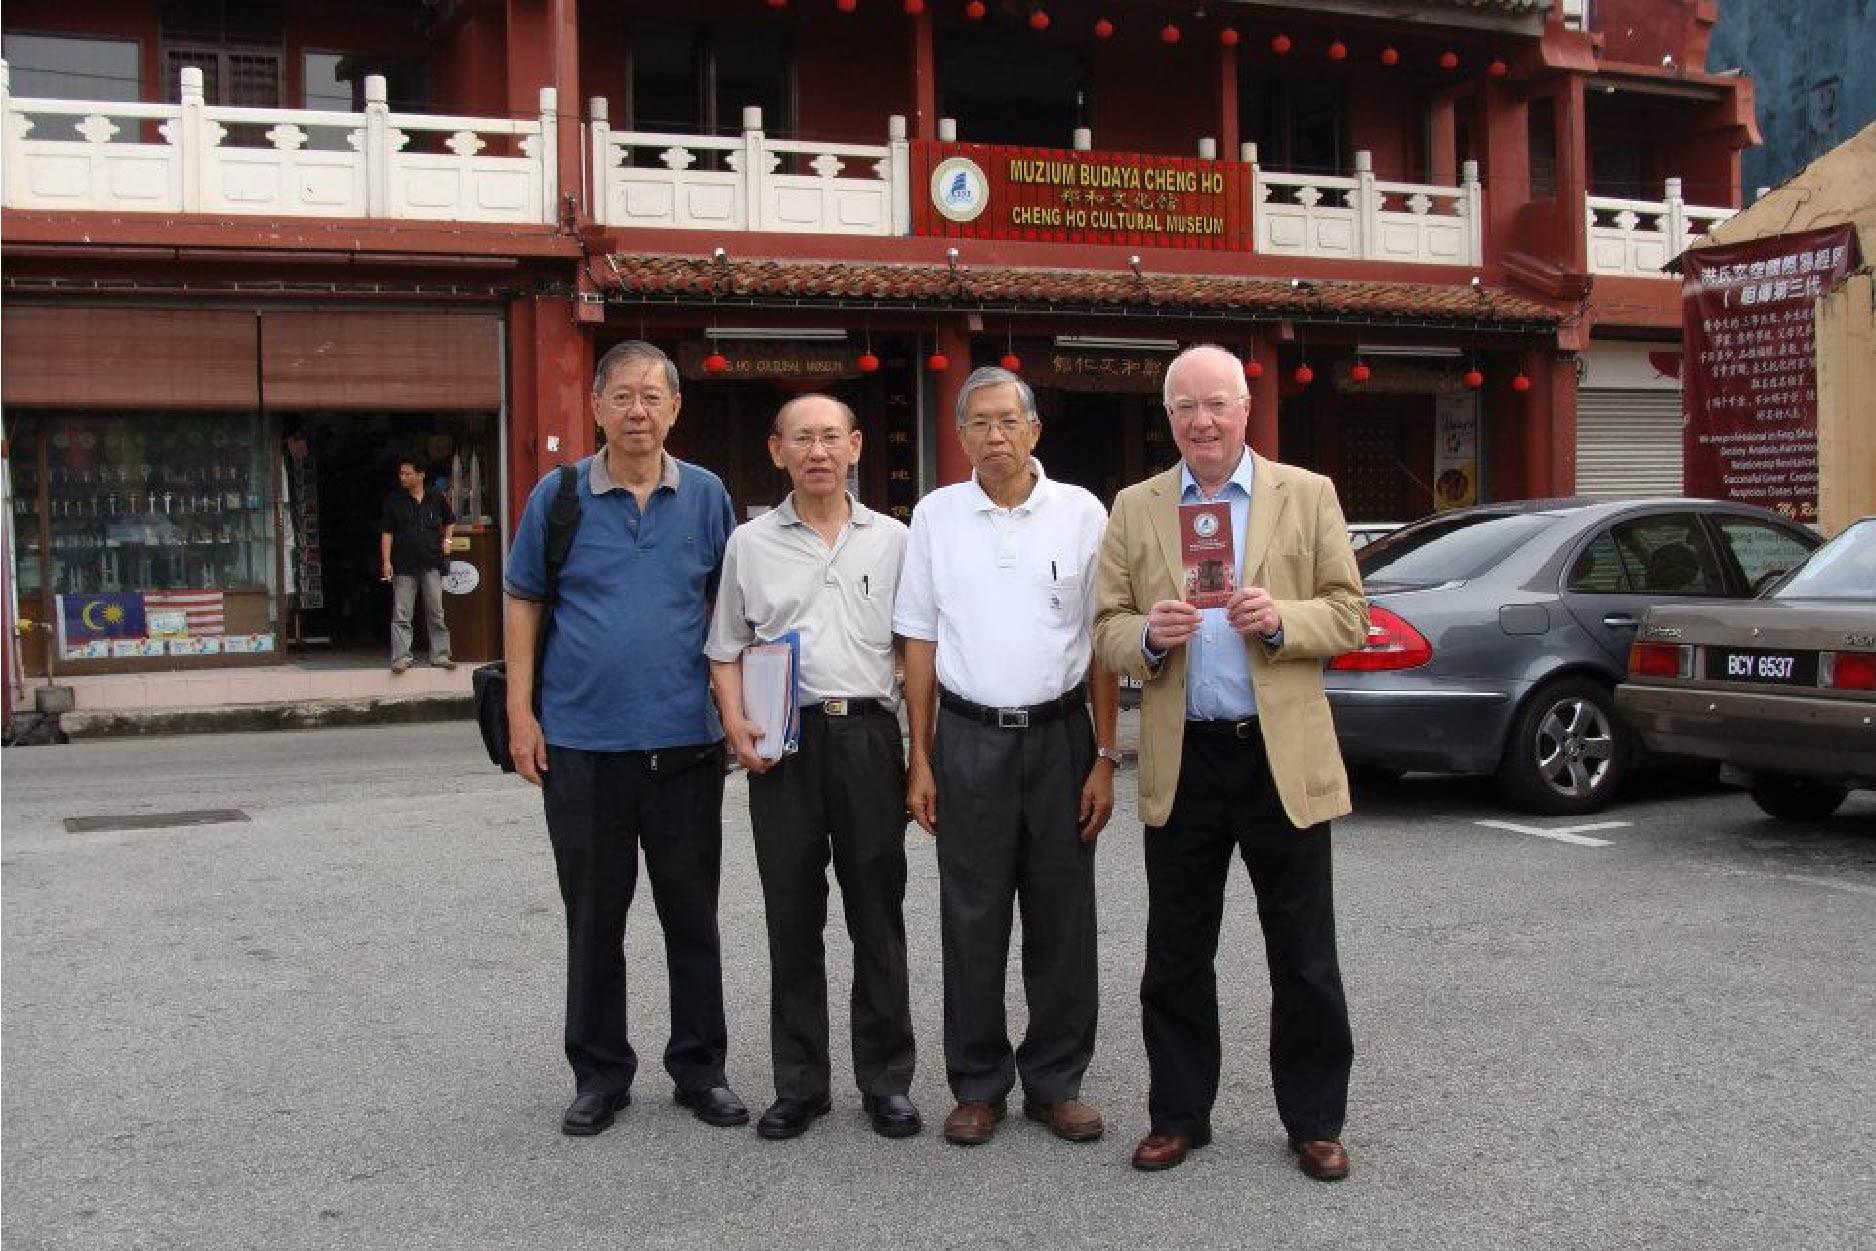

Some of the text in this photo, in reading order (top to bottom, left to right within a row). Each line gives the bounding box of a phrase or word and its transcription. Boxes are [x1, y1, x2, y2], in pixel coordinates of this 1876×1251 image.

[1010, 160, 1223, 194] MUZIUM BUDAYA CHENG HO
[1012, 206, 1224, 234] CHENG HO CULTURAL MUSEUM
[1728, 655, 1793, 677] BCY 6537
